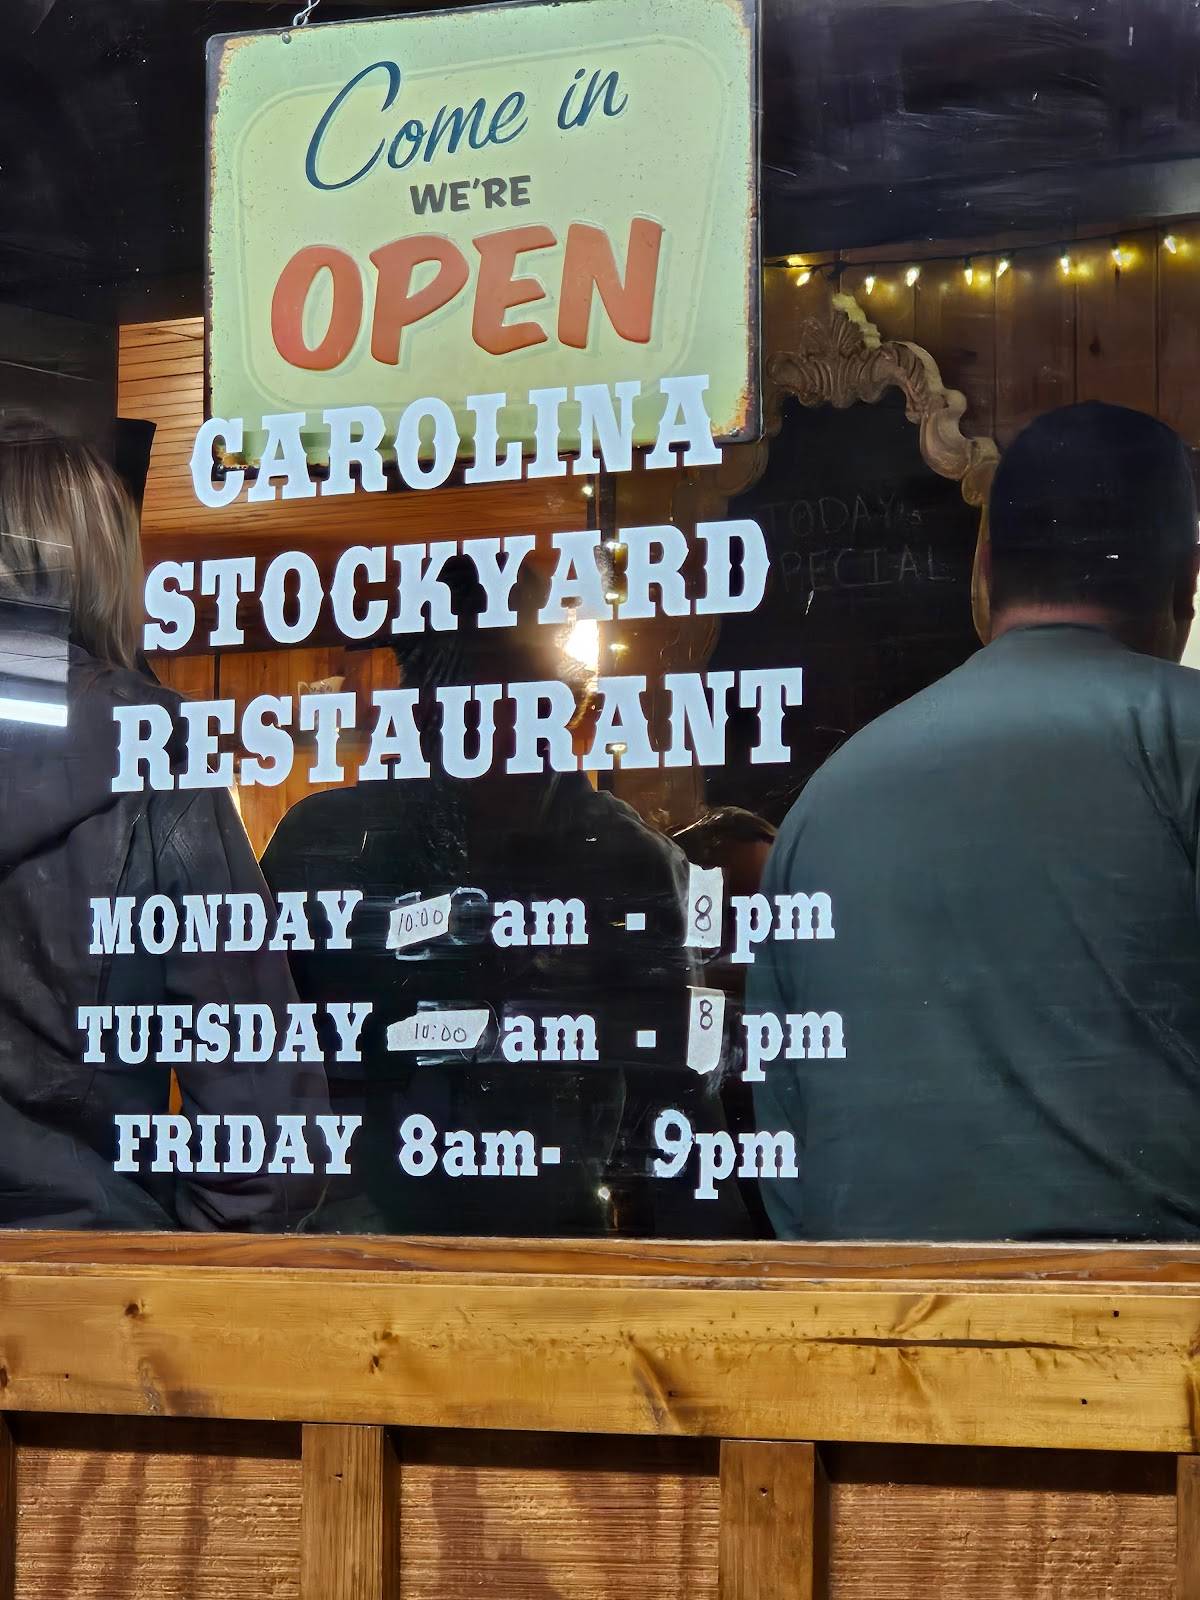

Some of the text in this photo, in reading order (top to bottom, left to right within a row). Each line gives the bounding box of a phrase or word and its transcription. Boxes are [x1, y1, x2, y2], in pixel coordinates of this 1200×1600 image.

[305, 61, 628, 190] Come in
[410, 175, 532, 215] WE'RE
[271, 217, 663, 371] OPEN
[189, 374, 723, 508] CAROLINA
[143, 519, 770, 651] STOCKYARD
[111, 667, 804, 793] RESTAURANT
[89, 890, 363, 954] MONDAY
[398, 908, 444, 935] 10:00
[492, 898, 589, 947] am
[695, 895, 712, 931] 8
[731, 892, 835, 963] pm
[78, 1002, 373, 1064] TUESDAY
[414, 1022, 467, 1043] 10:00
[502, 1014, 599, 1061] am
[700, 1000, 712, 1030] 8
[742, 1011, 846, 1082] pm
[113, 1114, 362, 1174] FRIDAY
[652, 1109, 798, 1199] 9pm
